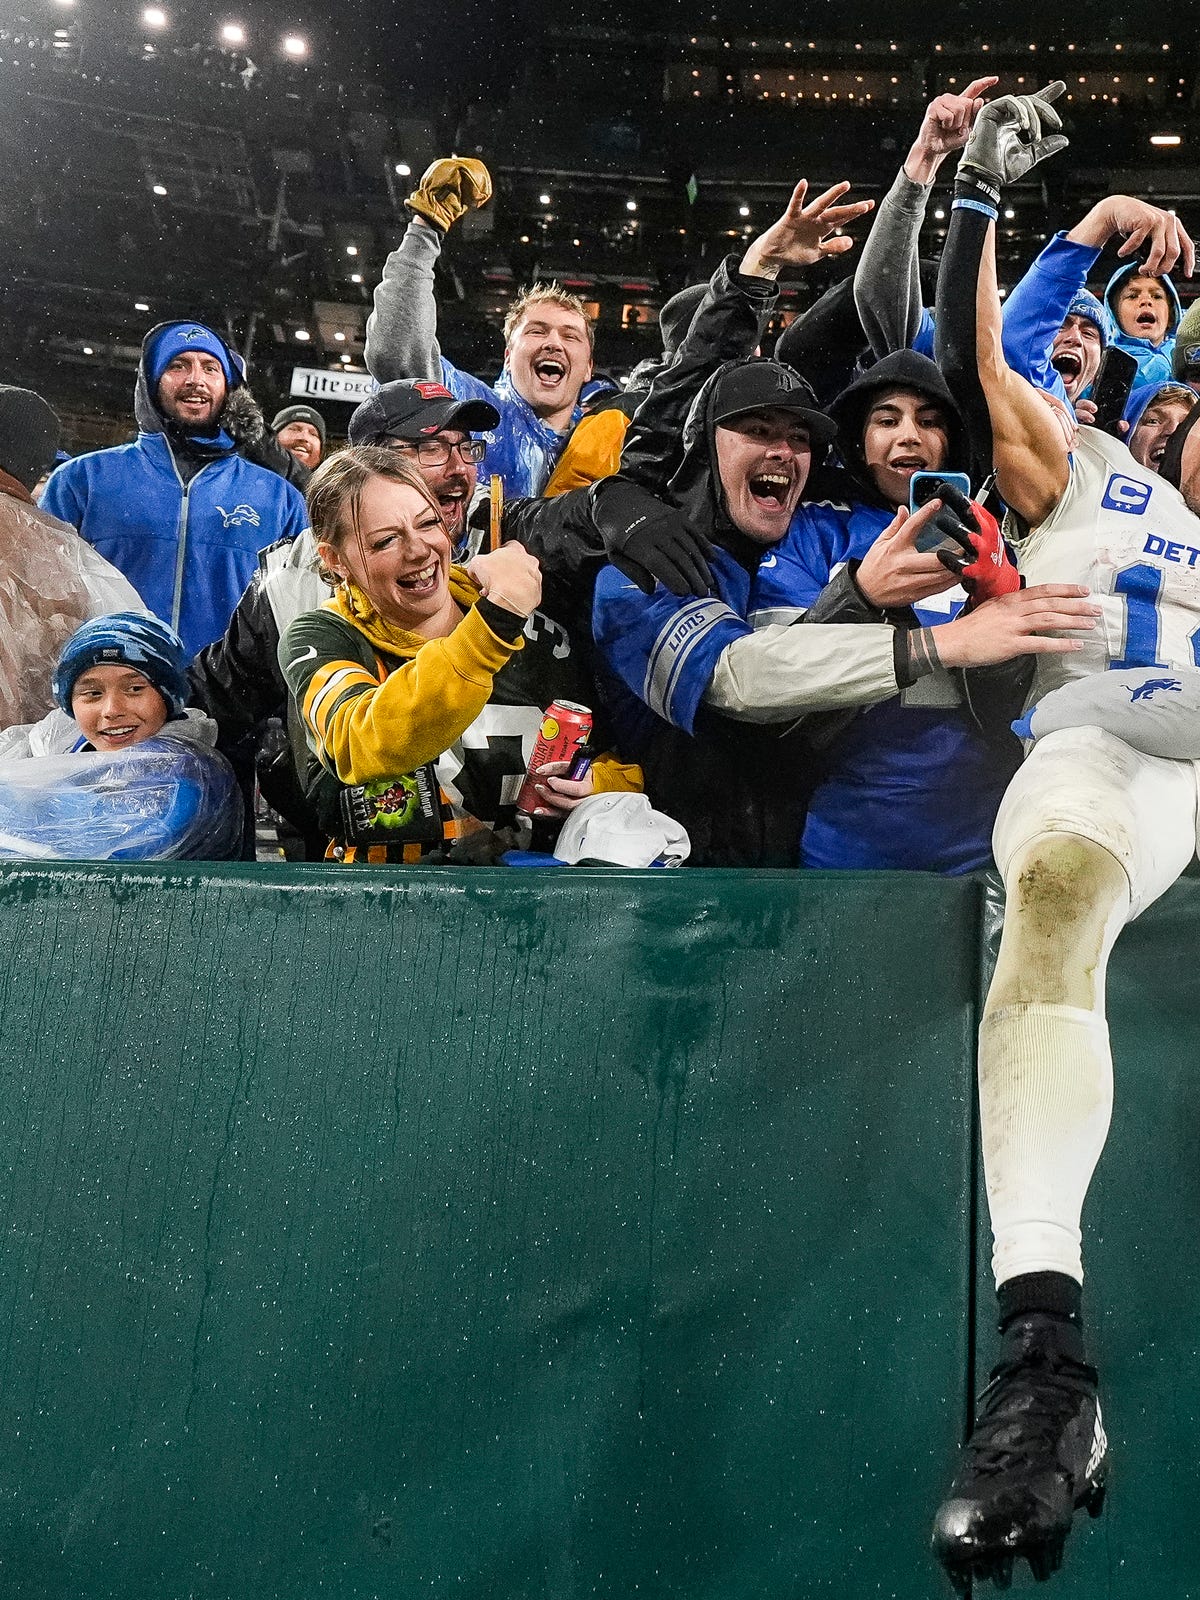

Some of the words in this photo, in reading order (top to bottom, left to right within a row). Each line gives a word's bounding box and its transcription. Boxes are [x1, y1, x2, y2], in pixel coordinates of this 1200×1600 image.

[303, 375, 339, 395] Lite
[1108, 477, 1150, 505] C
[624, 515, 647, 534] HEAD
[667, 612, 706, 653] LIONS
